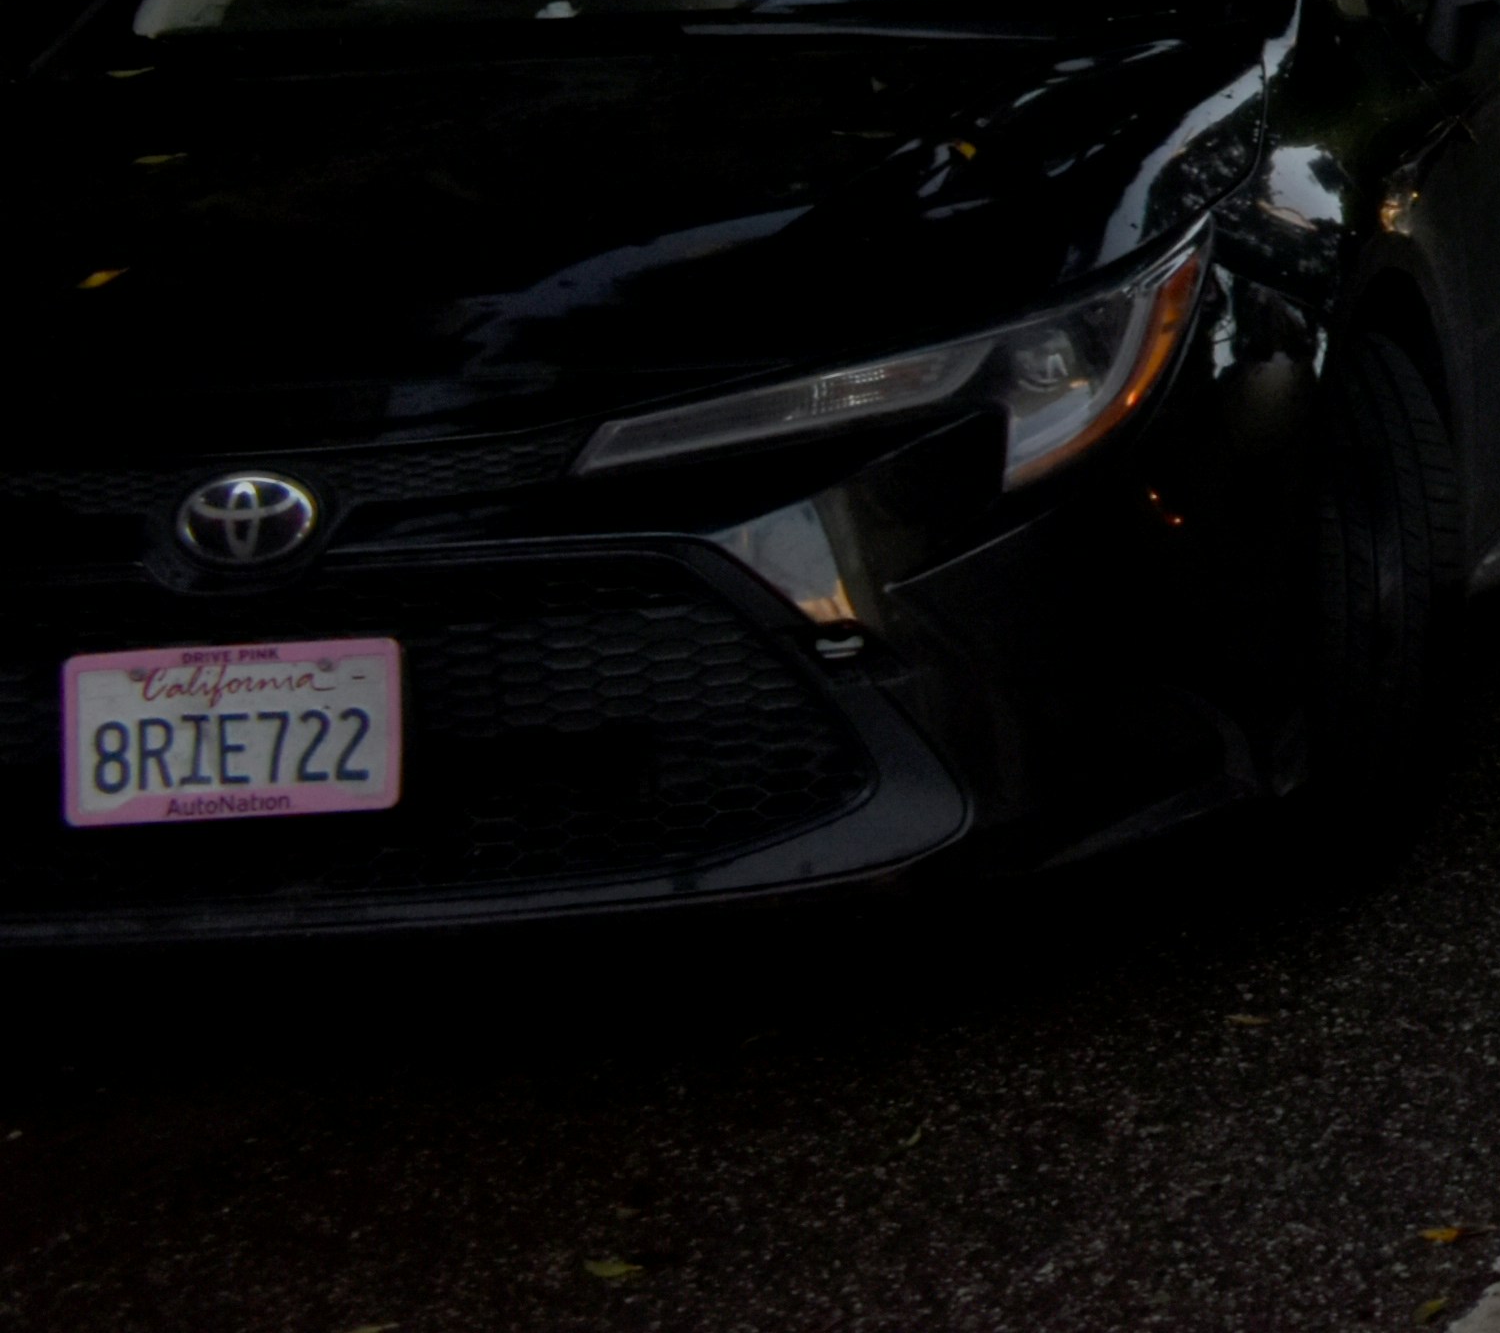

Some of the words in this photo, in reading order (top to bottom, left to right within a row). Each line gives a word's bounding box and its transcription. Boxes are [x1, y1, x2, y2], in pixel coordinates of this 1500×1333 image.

[181, 649, 233, 664] DRIVE
[238, 647, 281, 662] PINK
[142, 662, 336, 708] California
[94, 706, 372, 795] 8RIE722
[166, 793, 292, 818] AutoNation
